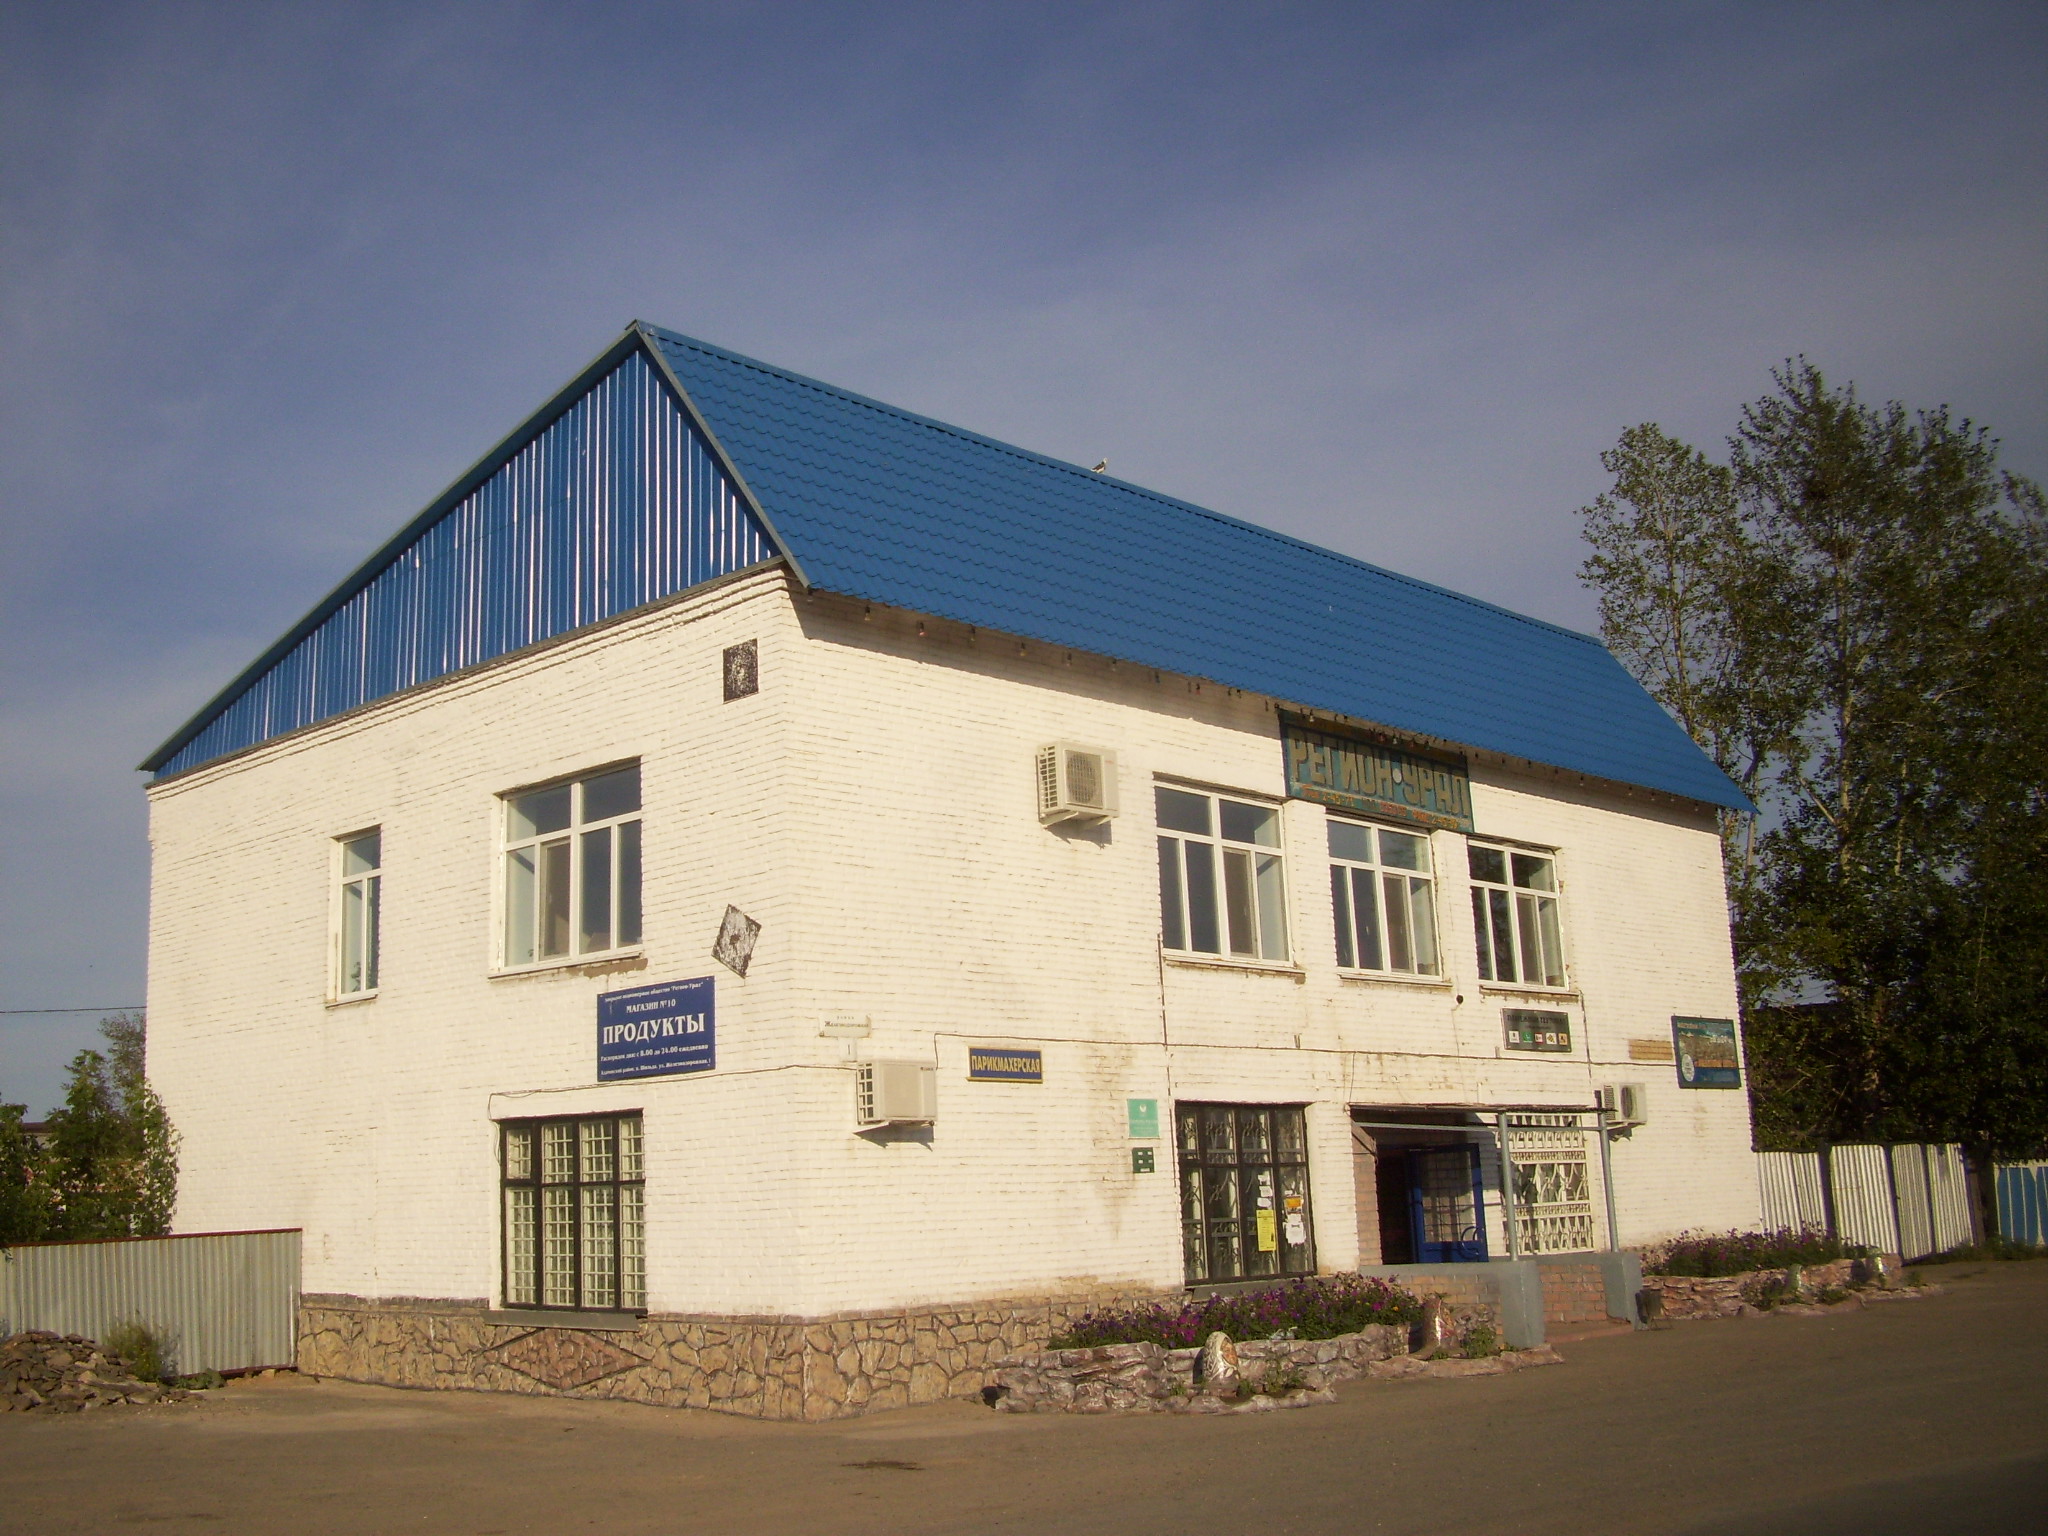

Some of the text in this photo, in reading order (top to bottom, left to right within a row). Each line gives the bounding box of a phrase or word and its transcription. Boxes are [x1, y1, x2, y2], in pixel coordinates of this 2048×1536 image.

[1288, 727, 1472, 819] РЕГИОН УРАЛ
[626, 1001, 659, 1014] МАГАЗИН
[603, 1013, 705, 1044] ПРОДУКТЫ
[640, 1048, 654, 1057] 8.00
[661, 1046, 678, 1055] 24.00
[971, 1055, 1041, 1073] ПАРИКМАХЕРСКАЯ
